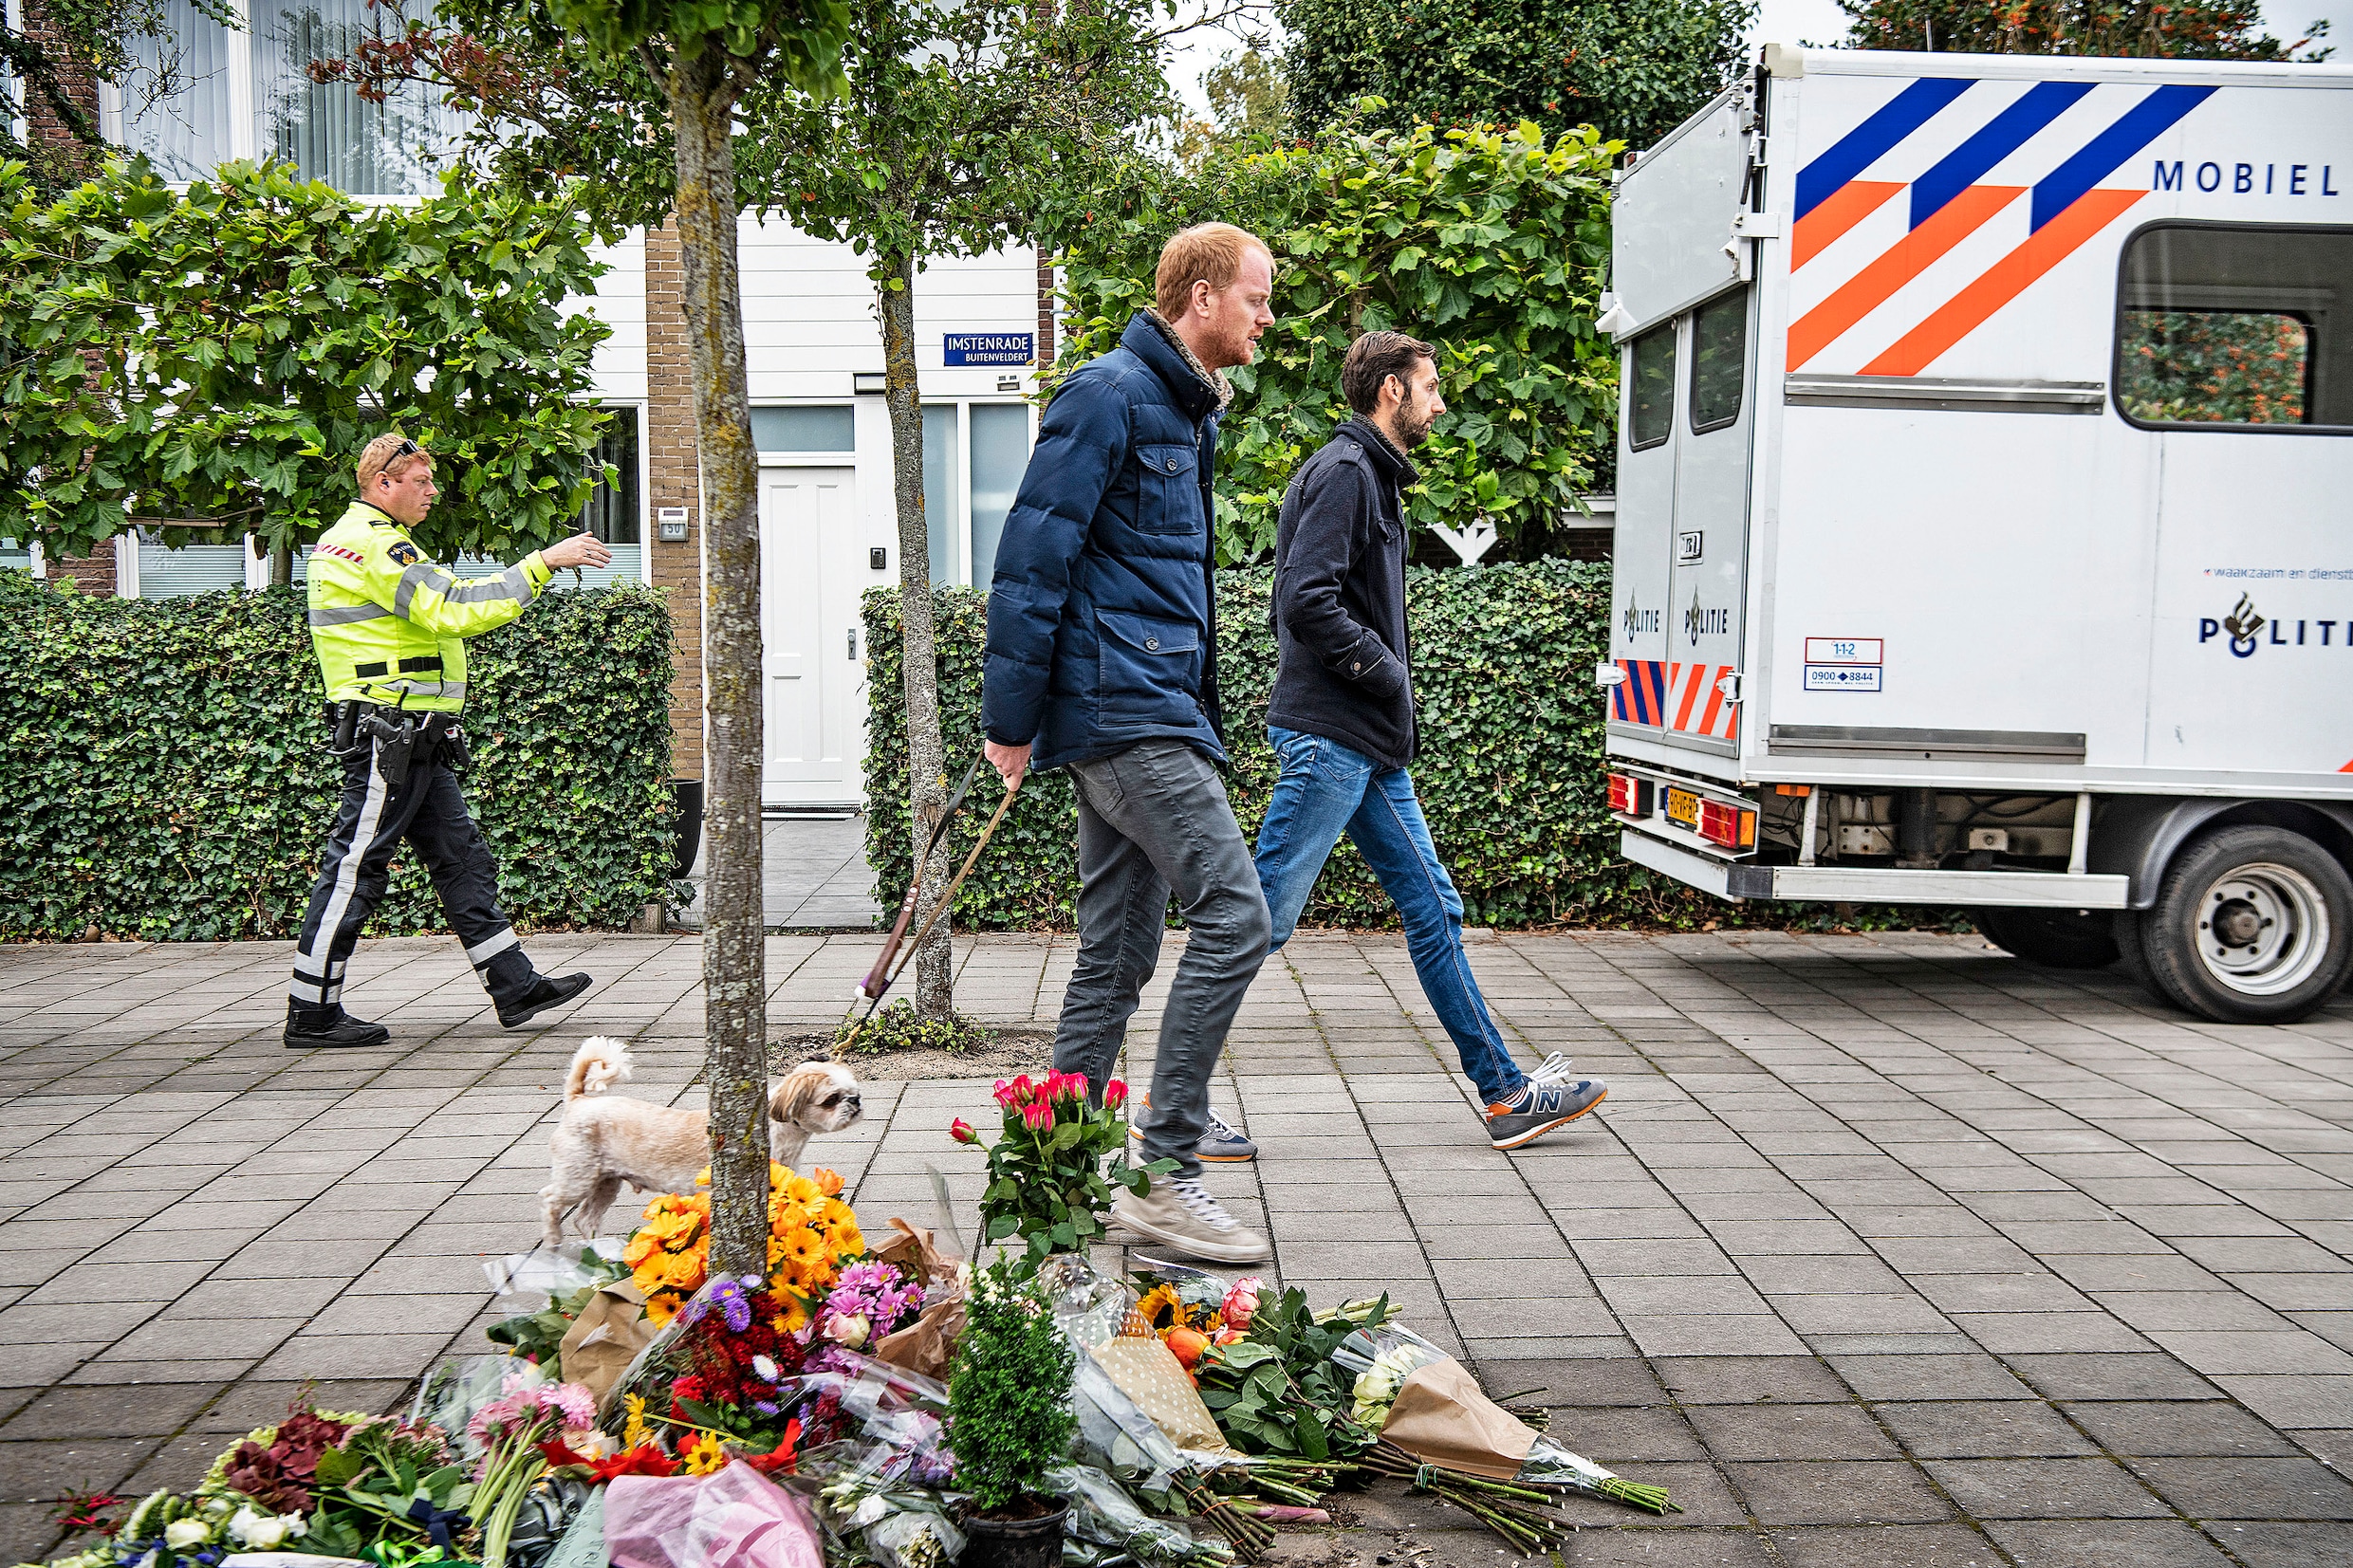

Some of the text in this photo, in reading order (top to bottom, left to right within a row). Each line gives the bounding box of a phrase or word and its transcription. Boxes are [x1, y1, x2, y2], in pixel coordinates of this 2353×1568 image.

[2153, 159, 2340, 196] MOBIEL
[948, 337, 1028, 350] IMSTENRADE
[965, 352, 1028, 362] BUITENVELDERT
[668, 524, 680, 534] 50
[1623, 609, 1659, 643] POLITIE
[1684, 609, 1728, 647] POLITIE
[1811, 672, 1873, 681] 0900 8844
[1536, 1090, 1562, 1114] N
